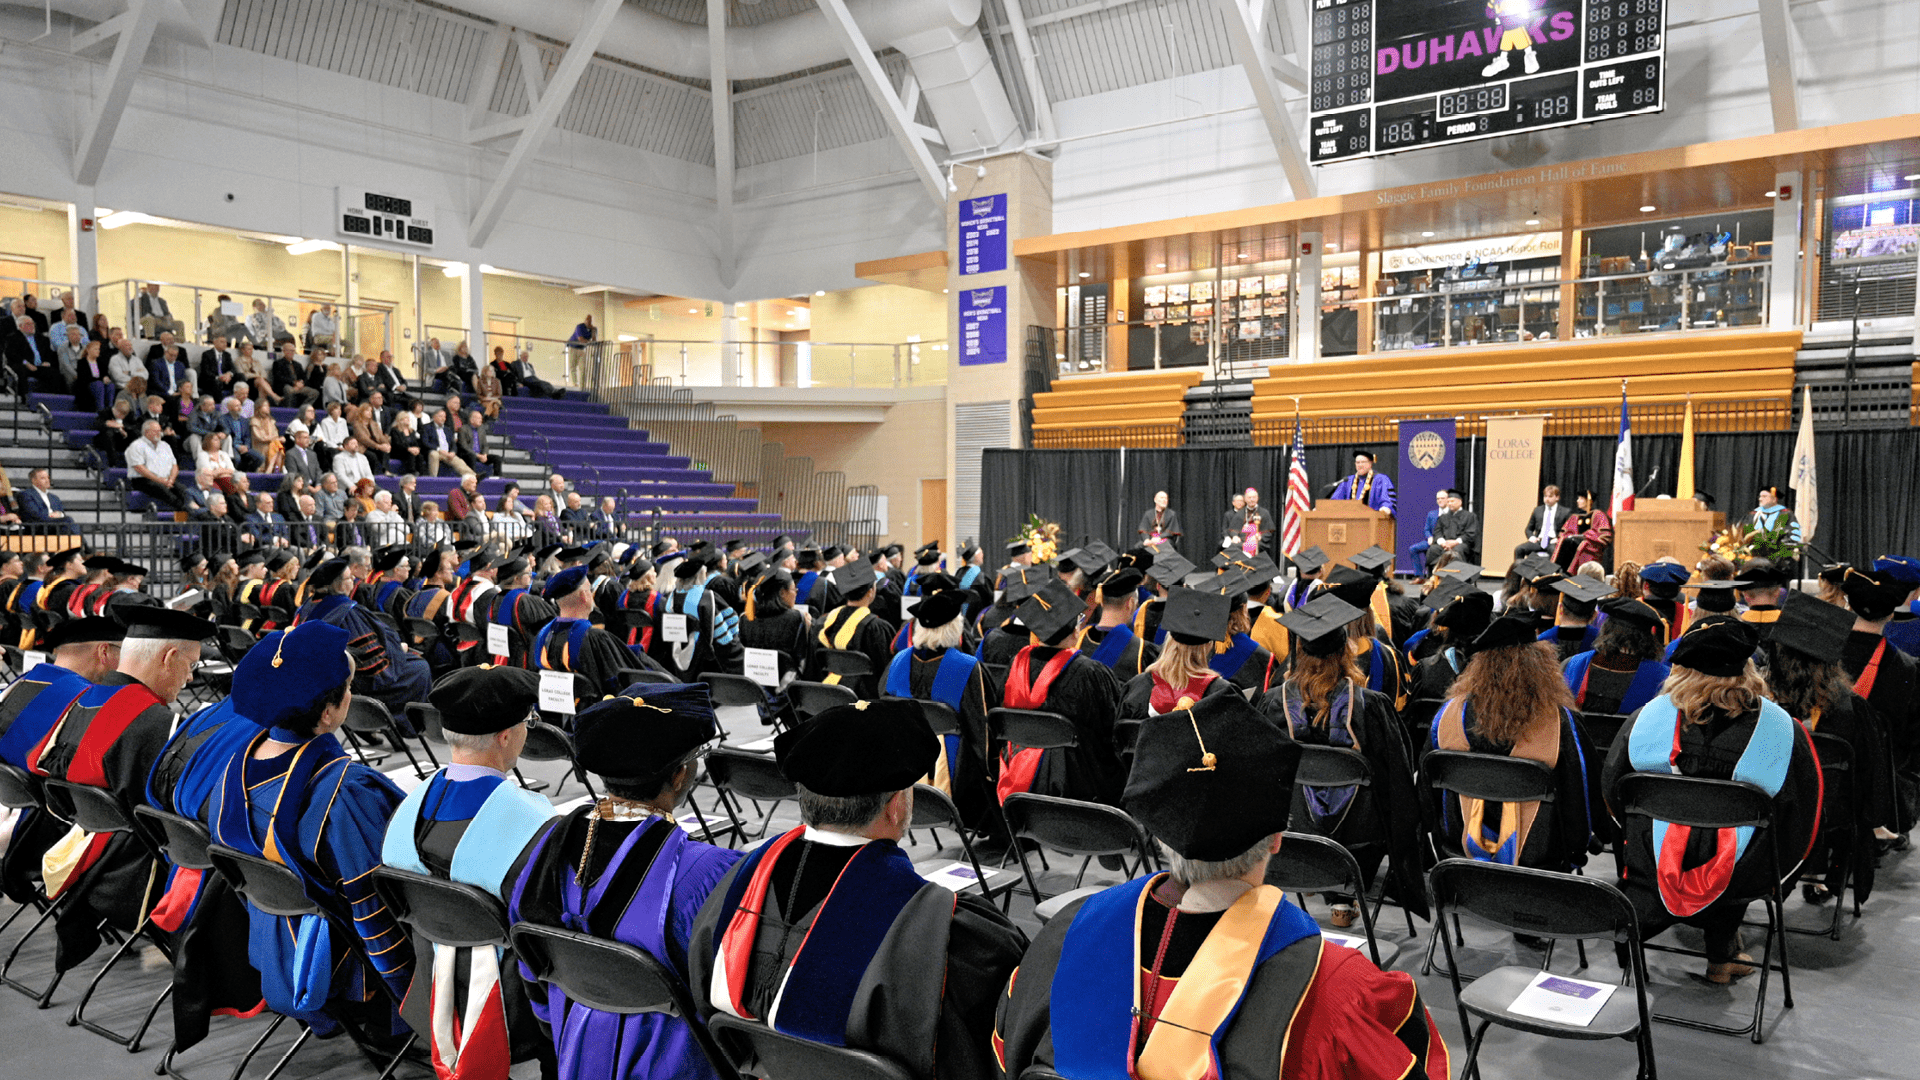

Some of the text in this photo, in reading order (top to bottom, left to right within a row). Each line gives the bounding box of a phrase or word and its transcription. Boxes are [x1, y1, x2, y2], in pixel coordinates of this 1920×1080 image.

[1599, 70, 1615, 79] TIME
[1589, 76, 1625, 88] OUTS LEFT
[1597, 93, 1616, 103] TEAM
[1595, 100, 1618, 111] FOULS
[1330, 125, 1343, 133] LEFT
[1447, 122, 1476, 136] PERIOD
[1377, 162, 1626, 205] Slaggie Family Foundation Hall of Fame
[412, 219, 429, 227] GUEST
[980, 216, 1005, 224] BASKETBALL
[1408, 253, 1461, 264] Conference
[1475, 247, 1504, 258] NCAA
[1507, 245, 1538, 254] Honor
[1541, 240, 1559, 250] Roll
[1498, 439, 1529, 448] LORAS
[1490, 450, 1534, 459] COLLEGE
